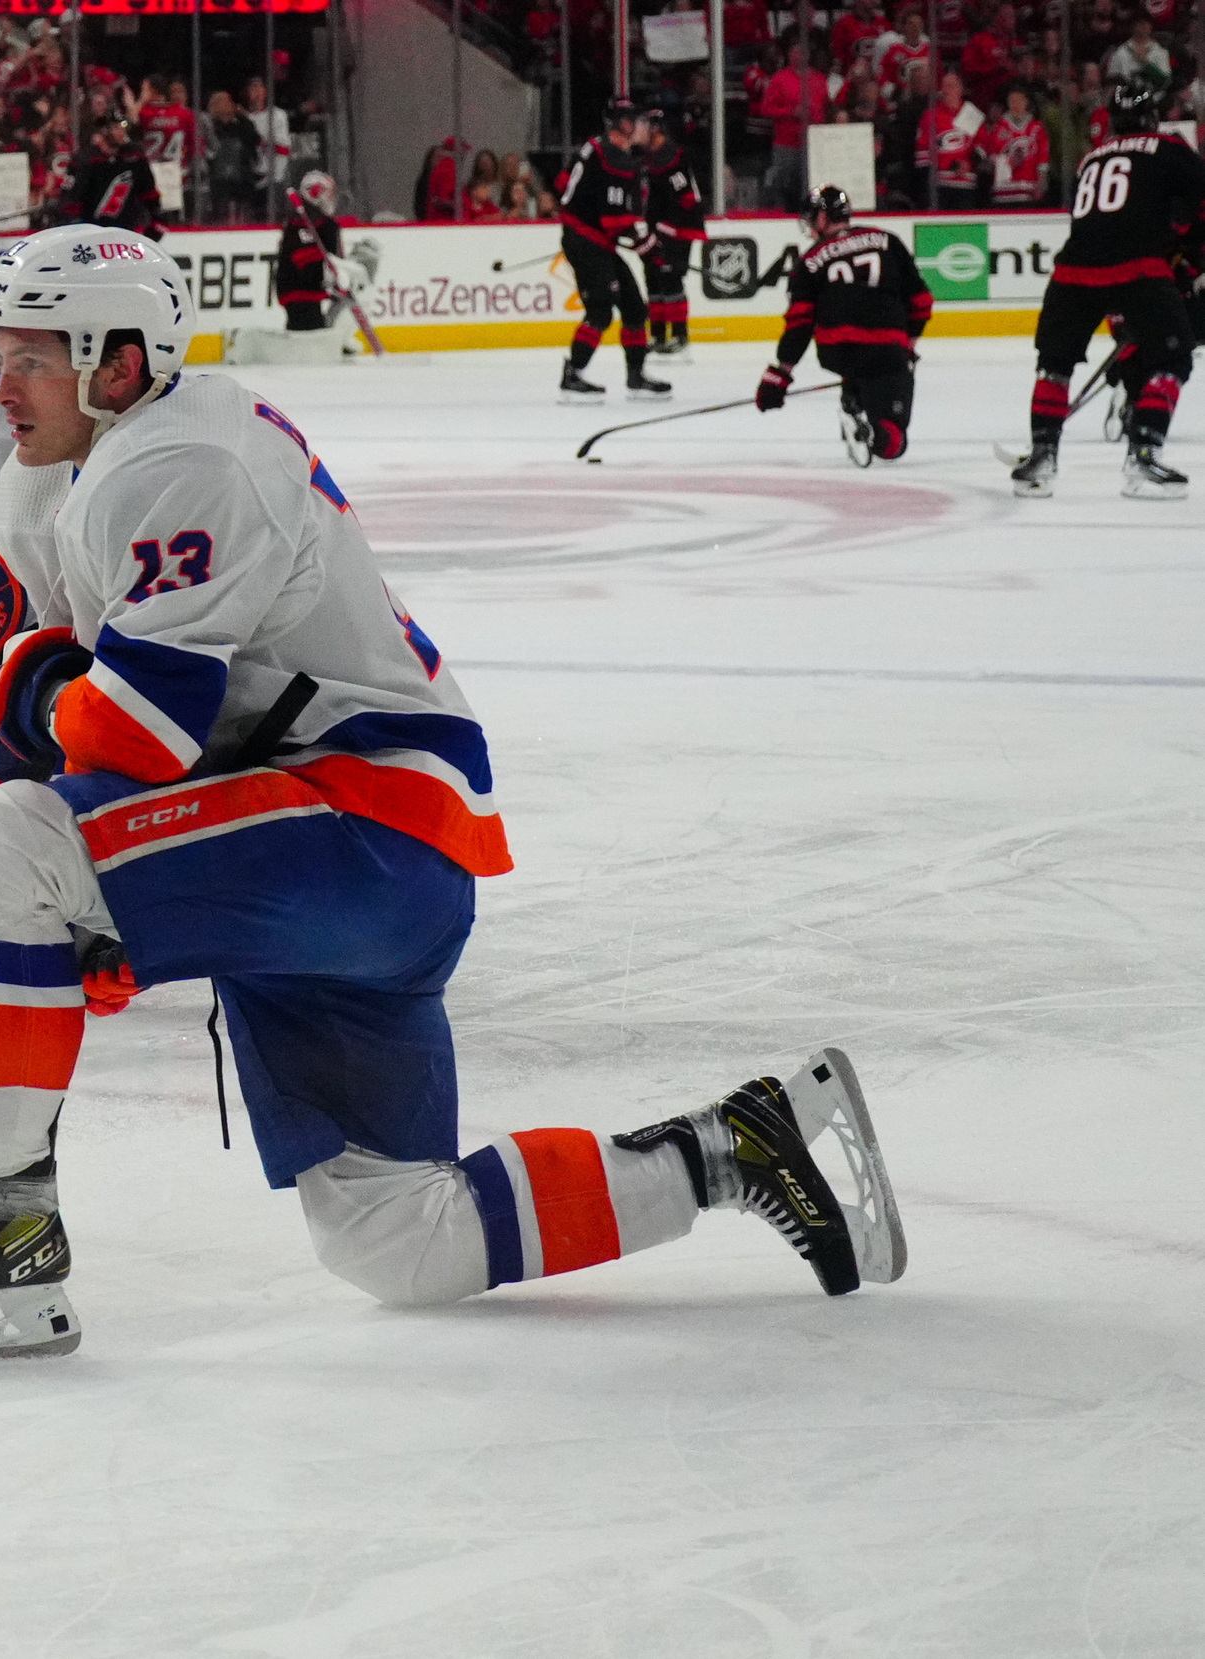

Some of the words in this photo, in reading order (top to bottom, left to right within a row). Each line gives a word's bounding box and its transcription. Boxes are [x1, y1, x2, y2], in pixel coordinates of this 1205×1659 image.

[1072, 156, 1132, 219] 86
[98, 243, 145, 260] UBS
[173, 254, 280, 310] BET
[124, 530, 213, 605] 13
[126, 800, 201, 832] CCM
[777, 1169, 819, 1217] CCM
